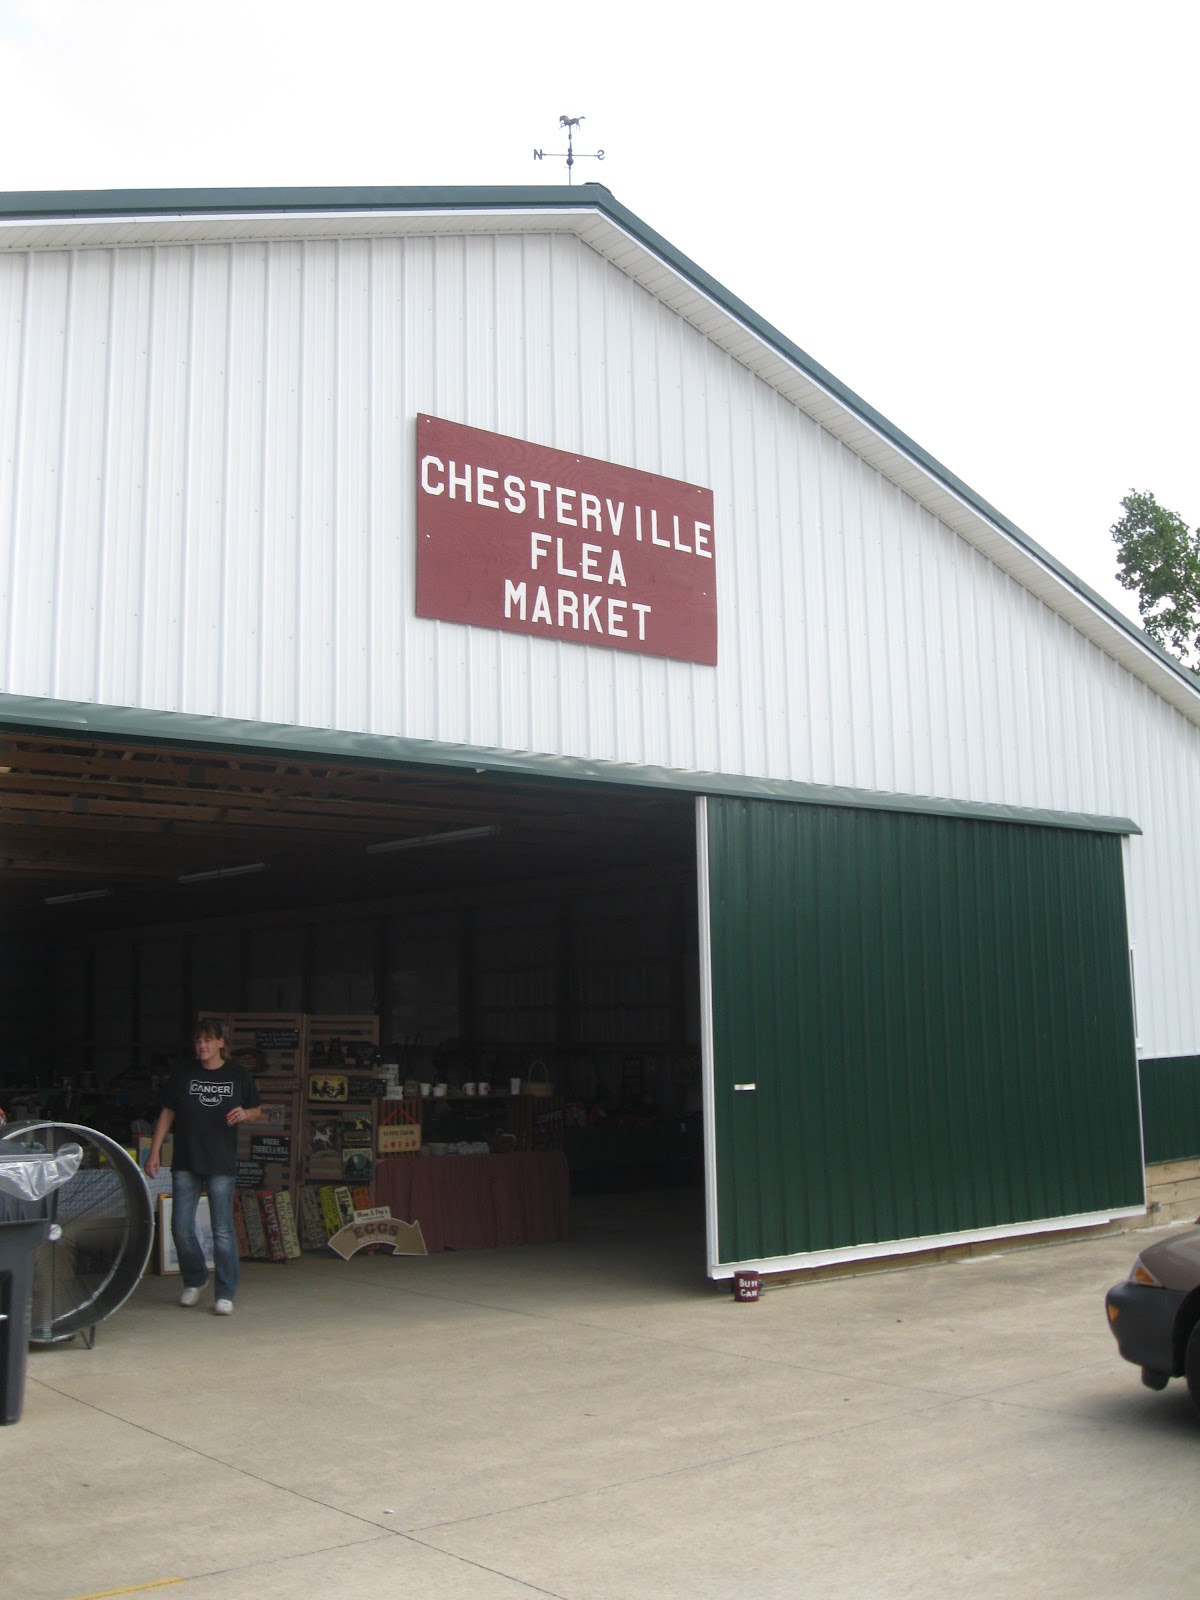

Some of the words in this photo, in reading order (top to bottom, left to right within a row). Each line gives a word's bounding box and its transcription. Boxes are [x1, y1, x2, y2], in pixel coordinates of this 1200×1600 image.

[533, 149, 543, 160] N
[421, 455, 712, 559] CHESTERVILLE
[531, 531, 627, 587] FLEA
[504, 579, 651, 641] MARKET
[191, 1083, 231, 1094] CANCER
[276, 1193, 294, 1255] CHOCOLATE
[353, 1222, 400, 1239] EGGS
